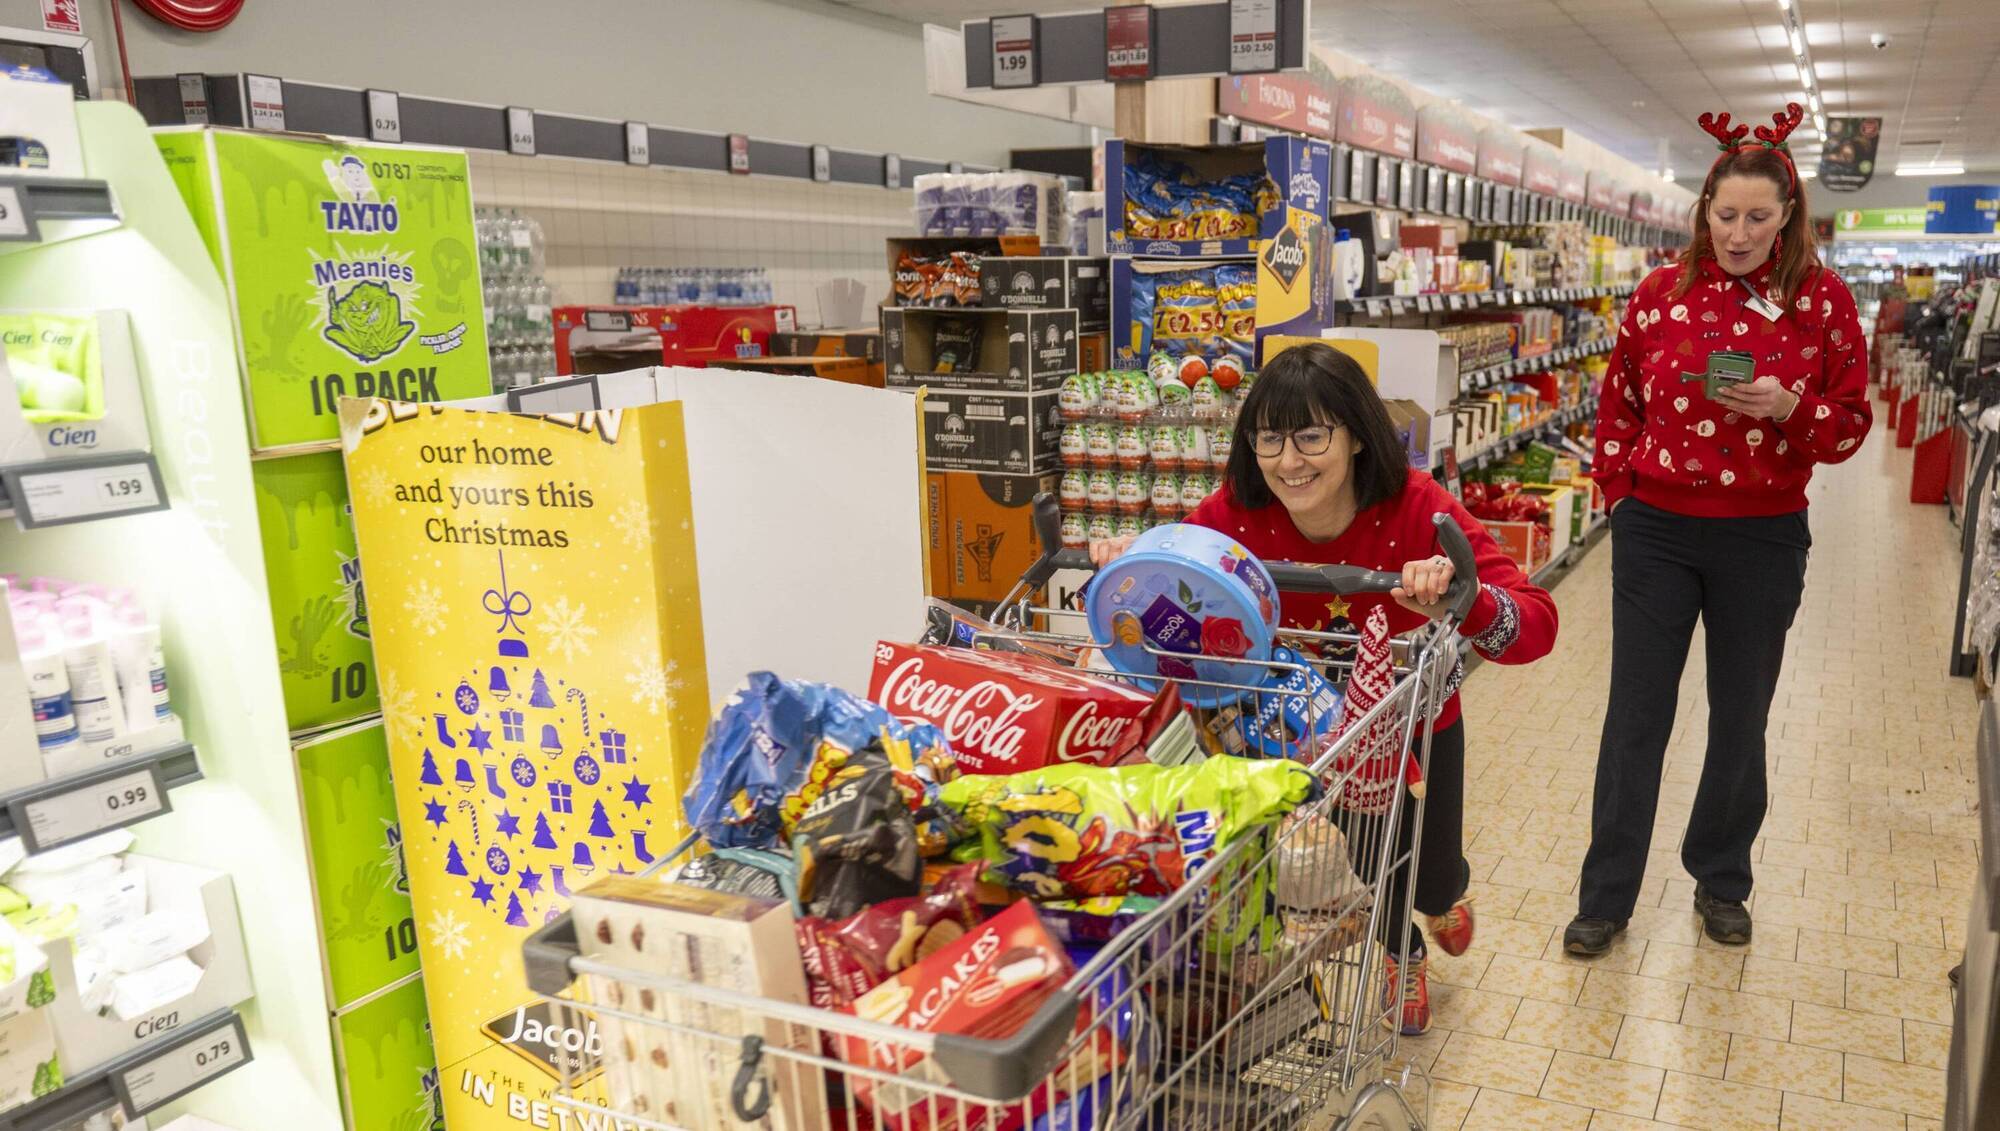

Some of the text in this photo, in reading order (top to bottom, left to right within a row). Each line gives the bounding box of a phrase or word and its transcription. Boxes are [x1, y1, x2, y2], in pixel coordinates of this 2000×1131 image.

[998, 55, 1027, 71] 1.99
[375, 118, 397, 130] 0.79
[372, 161, 411, 180] 0787
[321, 200, 399, 232] TAYTO
[1268, 236, 1304, 267] Jacobs
[313, 256, 415, 287] Meanies
[1168, 311, 1225, 333] €2.50
[310, 366, 441, 416] 10 PACK
[48, 426, 96, 449] Cien
[420, 438, 554, 467] our home
[105, 479, 142, 497] 1.99
[395, 478, 594, 510] and yours this
[425, 517, 570, 549] Christmas
[1158, 614, 1187, 642] ROSES
[876, 643, 895, 661] 20
[332, 662, 367, 703] 10
[880, 657, 1043, 763] Coca-Cola
[1057, 701, 1132, 761] Coca-
[104, 743, 133, 759] Cien
[953, 752, 984, 769] TASTE
[106, 786, 148, 811] 0.99
[872, 926, 1001, 1067] TACAKES
[134, 1009, 181, 1040] Cien
[500, 1005, 602, 1056] Jacob
[195, 1040, 231, 1067] 0.79
[461, 1068, 496, 1108] IN
[490, 1070, 525, 1092] THE
